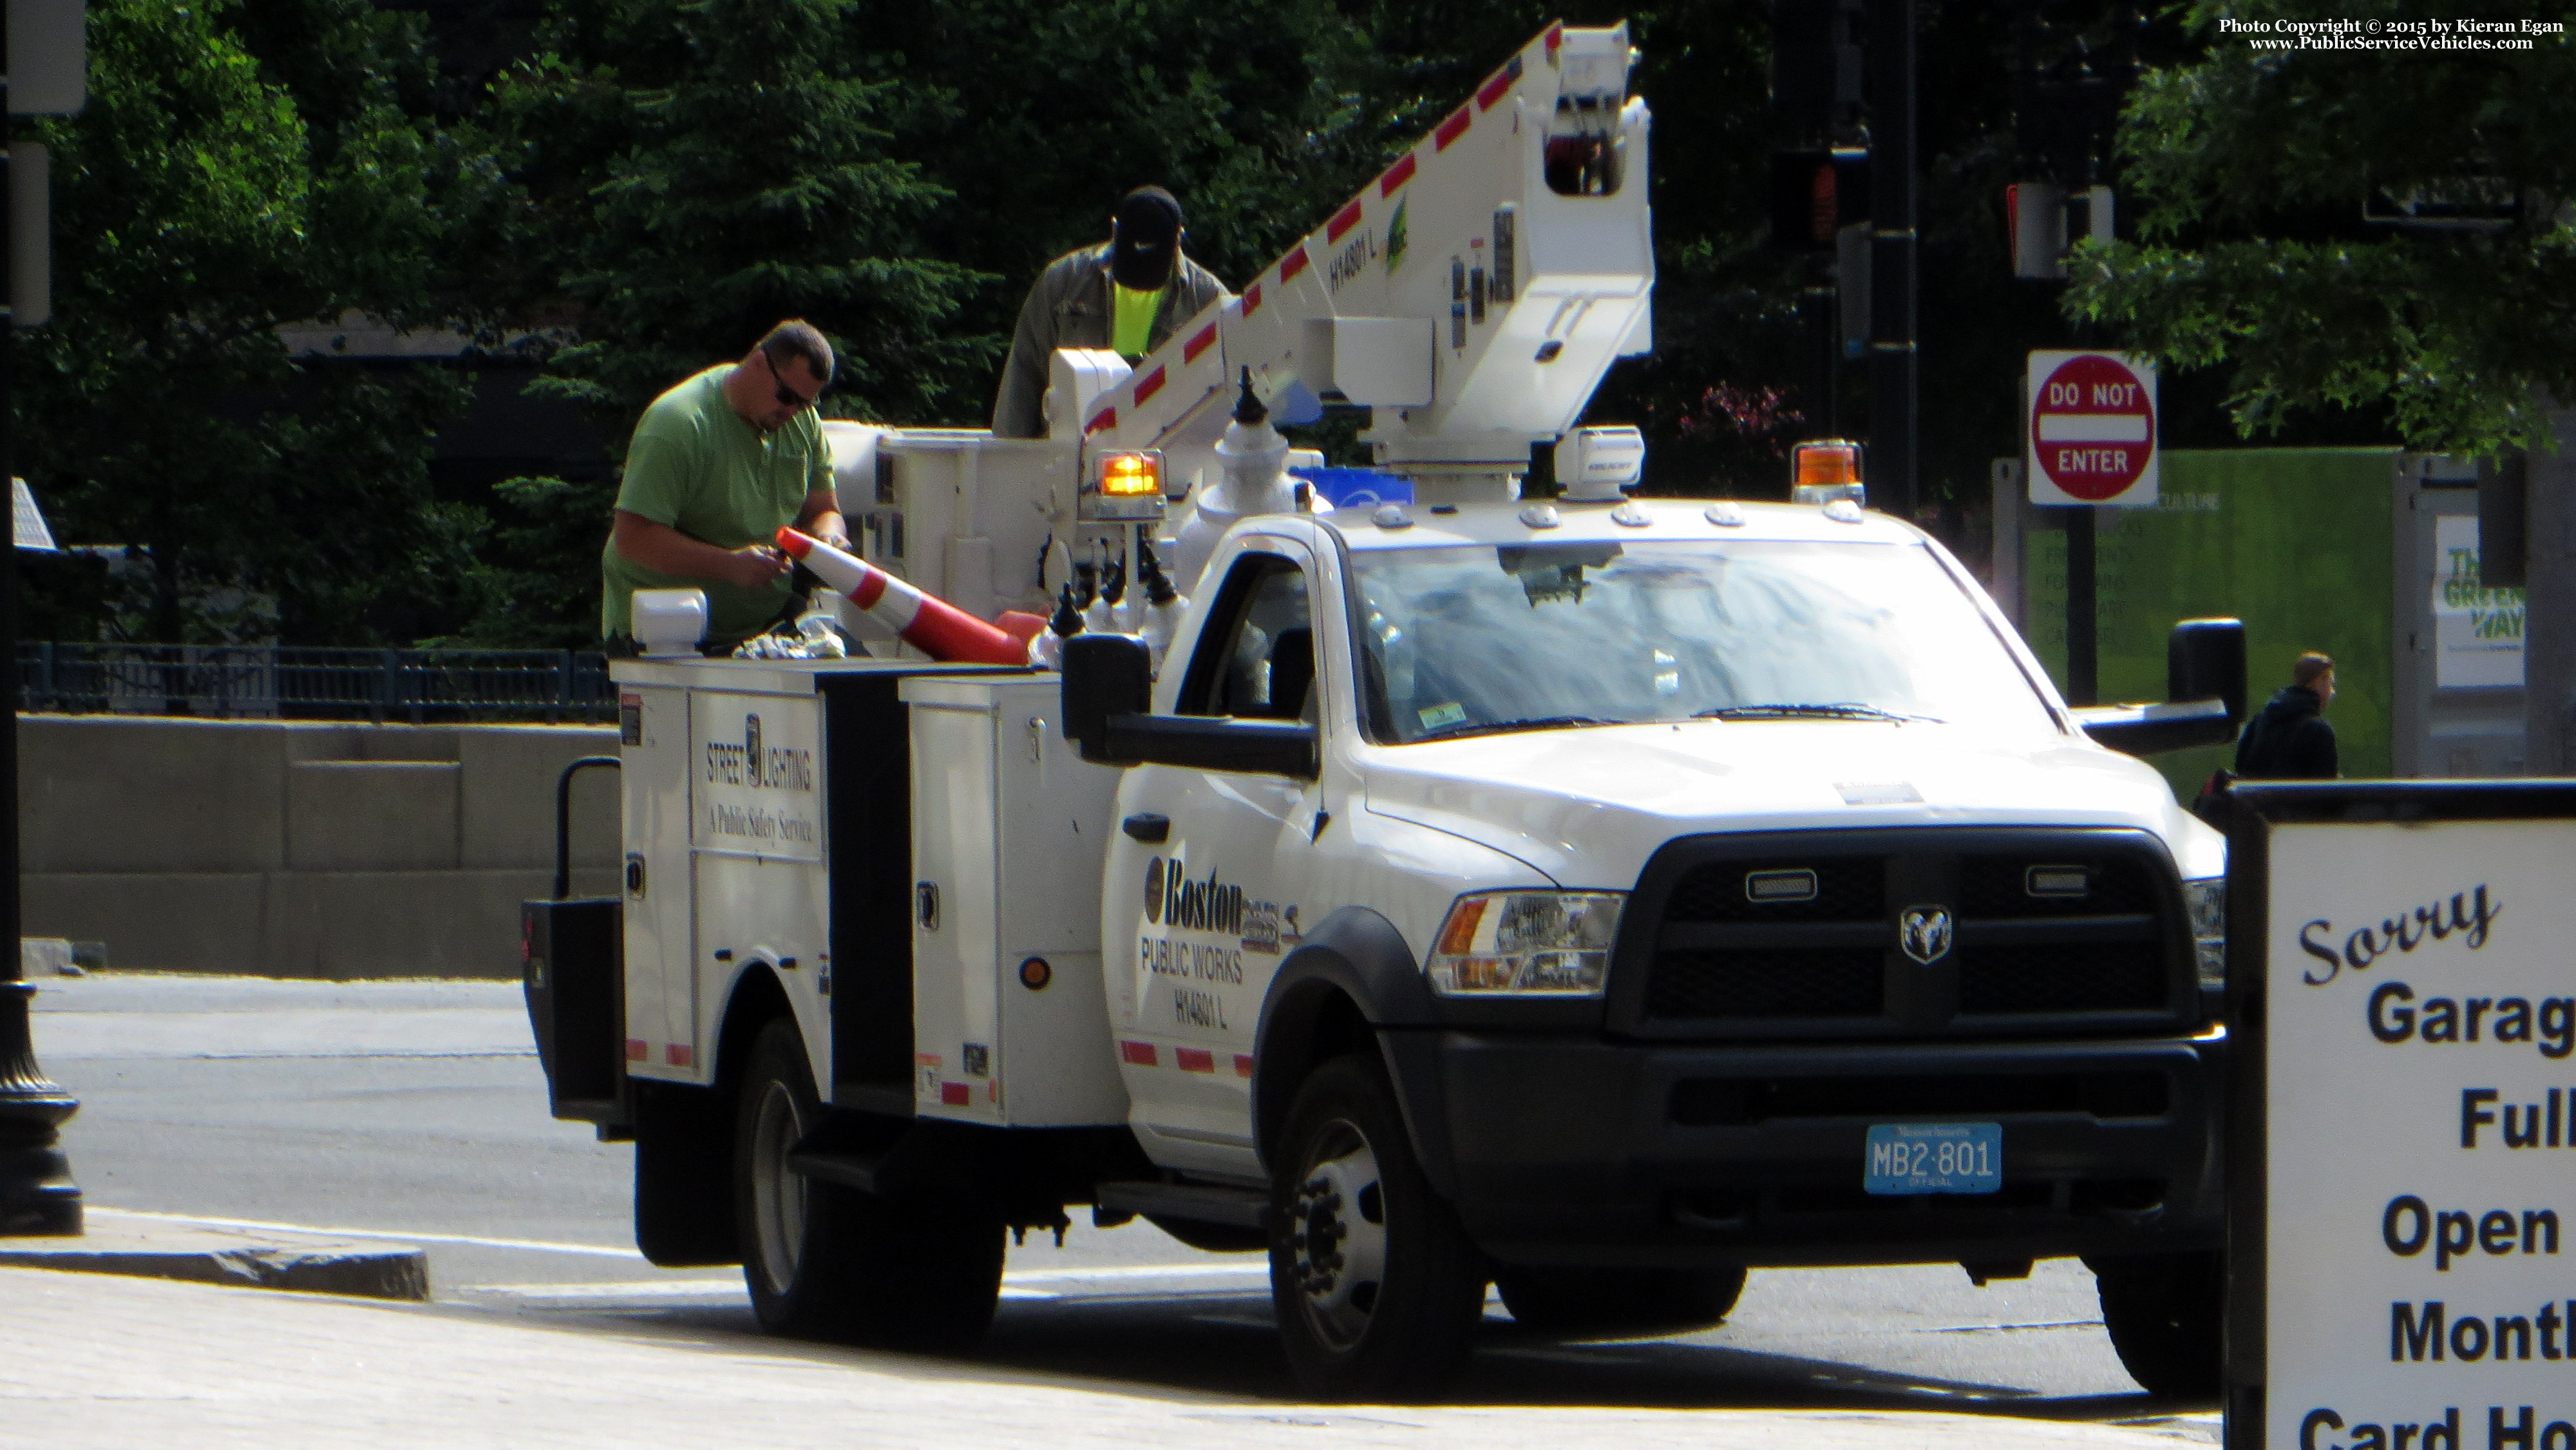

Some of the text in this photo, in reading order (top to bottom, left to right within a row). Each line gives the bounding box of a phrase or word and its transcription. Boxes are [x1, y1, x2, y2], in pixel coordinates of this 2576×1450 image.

[2050, 383, 2136, 406] DO NOT
[2058, 450, 2128, 473] ENTER
[2448, 548, 2480, 578] TH
[2470, 607, 2524, 638] WAY
[707, 742, 811, 791] STREET LIGHTING
[718, 804, 746, 836] Public
[749, 806, 775, 846] Safety
[779, 808, 811, 841] Service
[1165, 858, 1242, 935] Boston
[2298, 883, 2503, 987] Sorry
[1142, 937, 1243, 985] PUBLIC WORKS
[2367, 980, 2576, 1059] Garag
[2382, 1194, 2561, 1272] Open
[2300, 1406, 2576, 1450] Card Ho
